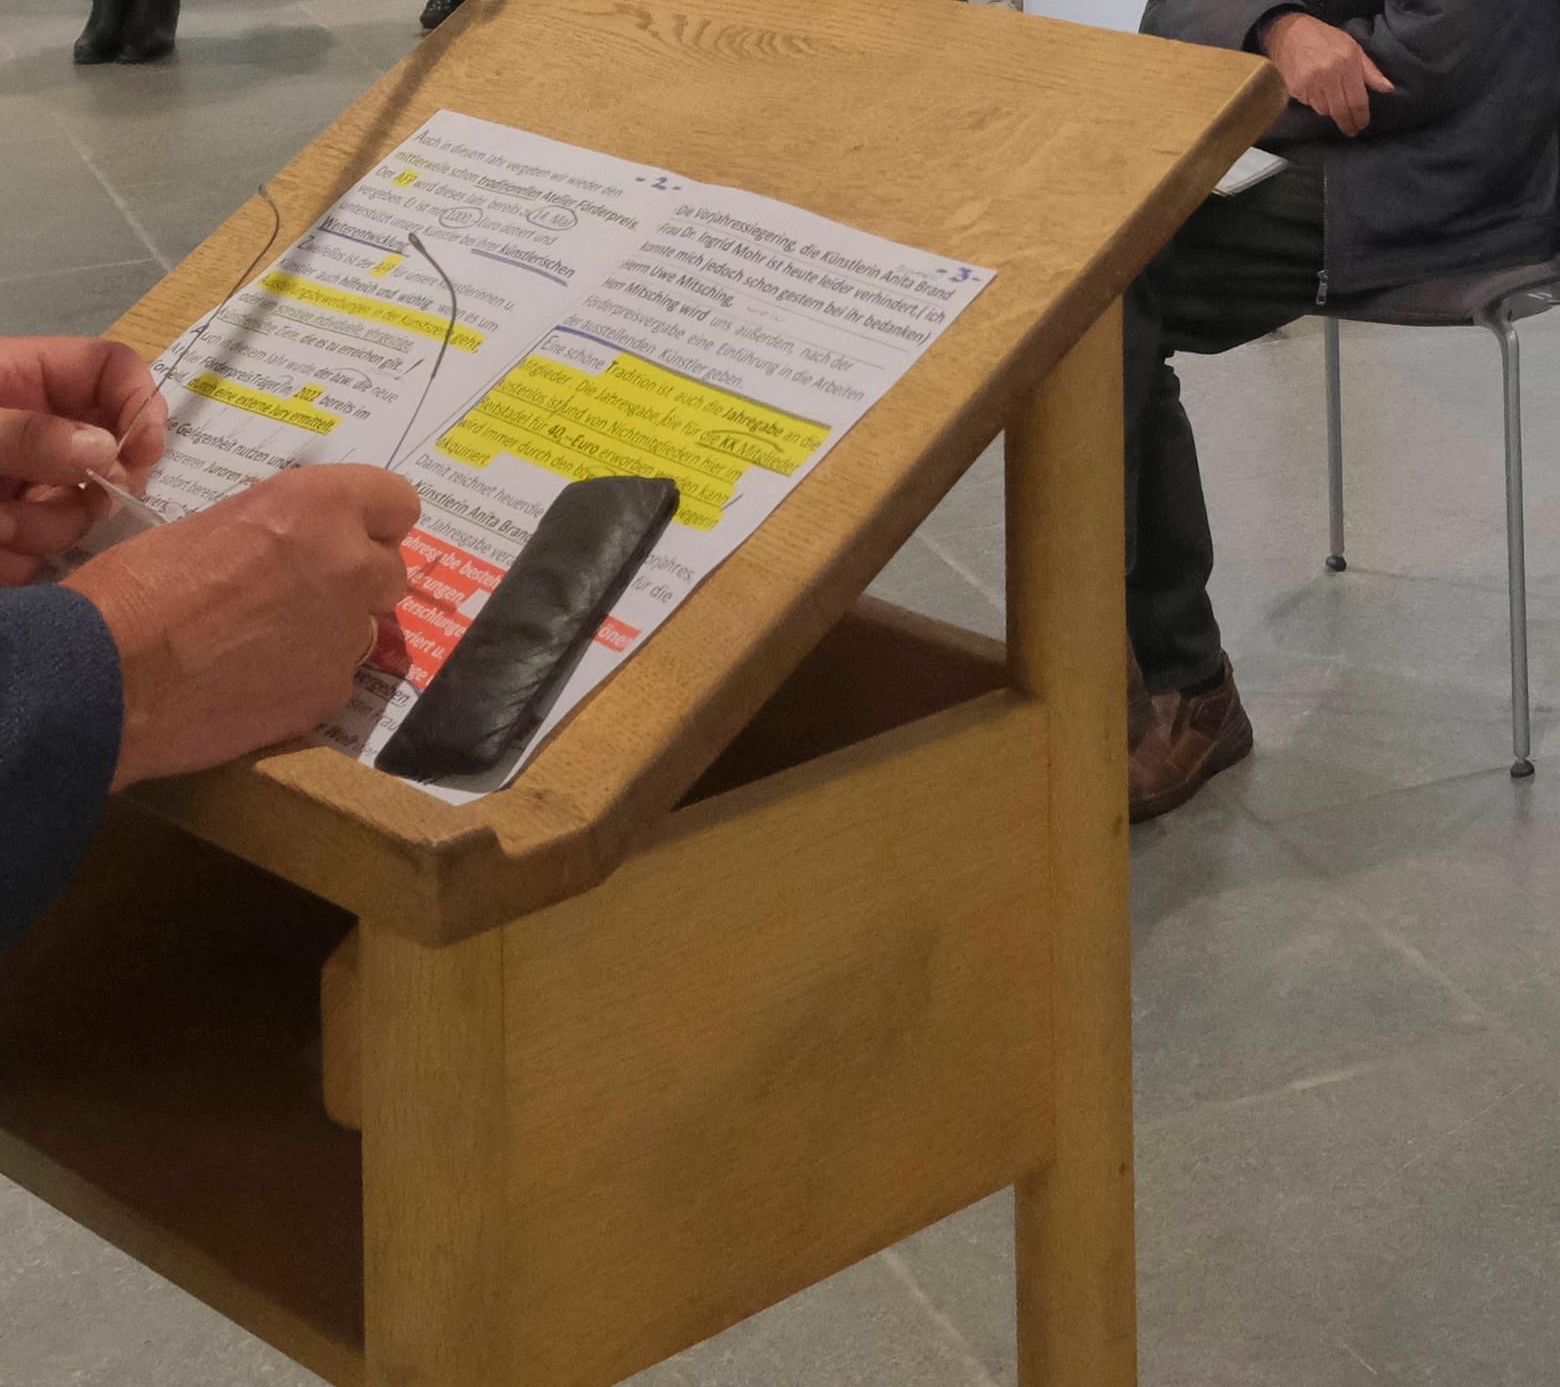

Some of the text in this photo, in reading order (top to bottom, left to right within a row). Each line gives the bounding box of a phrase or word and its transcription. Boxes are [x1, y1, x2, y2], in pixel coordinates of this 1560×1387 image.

[394, 152, 449, 172] mittlerweile
[449, 168, 479, 181] schon
[478, 174, 541, 197] traditionellen
[540, 190, 575, 206] Atelier
[414, 130, 446, 146] Auch
[440, 140, 452, 149] in
[450, 143, 486, 160] diesem
[485, 153, 505, 165] Jahr
[506, 162, 550, 177] vergeben
[567, 177, 602, 191] wieder
[601, 184, 622, 196] den
[375, 166, 394, 179] Der
[413, 180, 438, 190] wird
[435, 184, 465, 199] dieses
[487, 199, 519, 214] bereits
[339, 201, 393, 222] unterstützt
[390, 217, 423, 232] unsere
[459, 234, 479, 245] bei
[499, 243, 575, 277] künstlerischen
[533, 234, 558, 246] und
[406, 271, 437, 285] unsere
[619, 257, 734, 308] Herrn Uwe Mitsching,
[657, 221, 680, 235] Frau
[696, 231, 735, 250] Ingrid
[731, 242, 767, 262] Mohr
[767, 254, 786, 269] ist
[783, 261, 818, 282] heute
[818, 274, 854, 294] leider
[924, 308, 948, 323] ich
[800, 242, 820, 258] die
[820, 250, 881, 277] Künstlerin
[880, 268, 915, 288] Anita
[914, 279, 957, 300] Brand
[375, 288, 399, 298] und
[464, 313, 478, 323] es
[478, 318, 499, 330] um
[601, 276, 624, 291] Herr
[623, 283, 679, 312] Mitsching
[678, 304, 710, 321] wird
[709, 317, 732, 330] uns
[799, 348, 833, 364] nach
[829, 355, 852, 372] der
[674, 251, 706, 265] mich
[699, 257, 746, 281] jedoch
[743, 276, 780, 294] schon
[776, 288, 826, 309] gestern
[824, 300, 848, 316] bei
[863, 313, 933, 347] bedanken)
[337, 344, 384, 364] erreichen
[562, 314, 581, 327] der
[580, 322, 656, 354] ausstellenden
[658, 347, 707, 375] Künstler
[582, 294, 864, 402] Förderpreisvergabe eine Einführung in die Arbeiten
[236, 394, 274, 412] externe
[314, 365, 333, 379] der
[369, 386, 399, 403] neue
[319, 392, 356, 413] bereits
[353, 403, 371, 419] im
[540, 335, 821, 450] Eine schöne Tradition ist auch die Jahregabe an die
[176, 420, 296, 468] Gelegenheit nutzen und
[459, 418, 573, 472] wird immer durch den
[527, 417, 546, 432] für
[598, 449, 654, 475] erworben
[560, 405, 587, 419] und
[583, 414, 608, 429] von
[607, 421, 701, 465] Nichtmitgliedern
[700, 456, 724, 474] hier
[724, 465, 742, 480] im
[575, 379, 596, 396] Die
[681, 421, 699, 436] für
[699, 427, 721, 444] die
[720, 435, 741, 450] KK
[737, 441, 798, 474] Mitglieder
[417, 453, 453, 475] Damit
[448, 470, 498, 495] zeichnet
[412, 479, 500, 527] Künstlerin Anita
[429, 516, 491, 554] Jahresgabe
[649, 583, 673, 603] die
